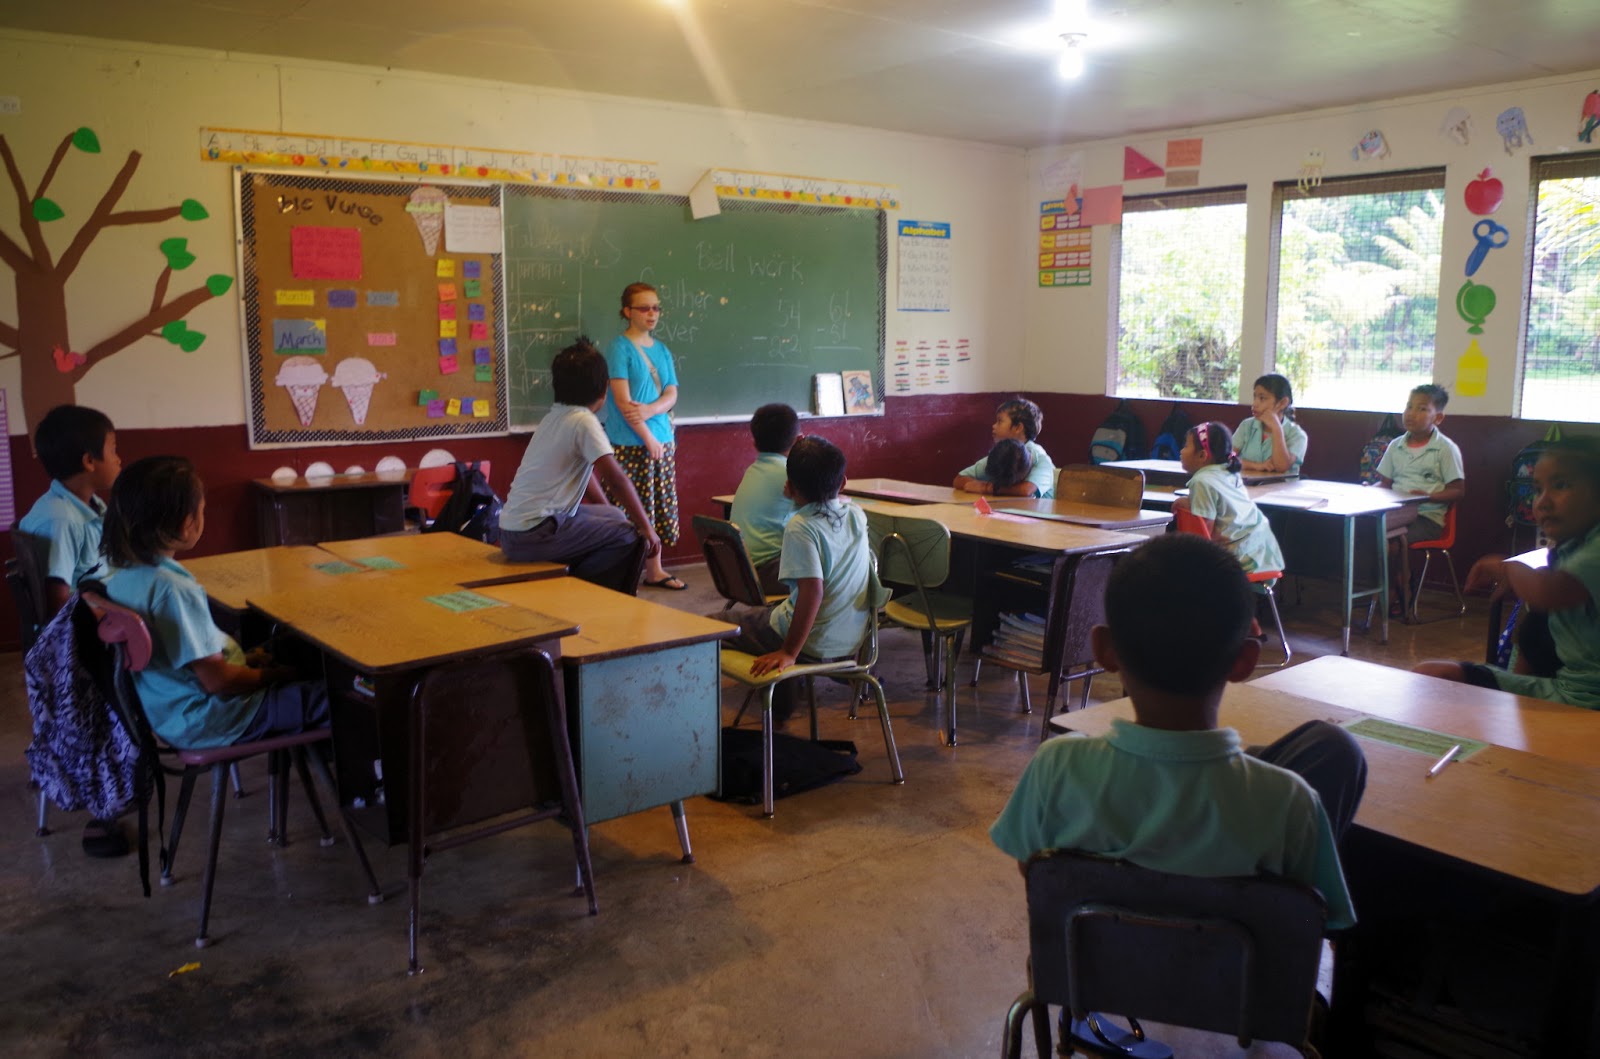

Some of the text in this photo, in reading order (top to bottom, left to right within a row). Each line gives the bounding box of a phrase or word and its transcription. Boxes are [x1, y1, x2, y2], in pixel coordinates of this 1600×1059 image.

[696, 240, 804, 281] Bell work
[278, 330, 322, 349] March
